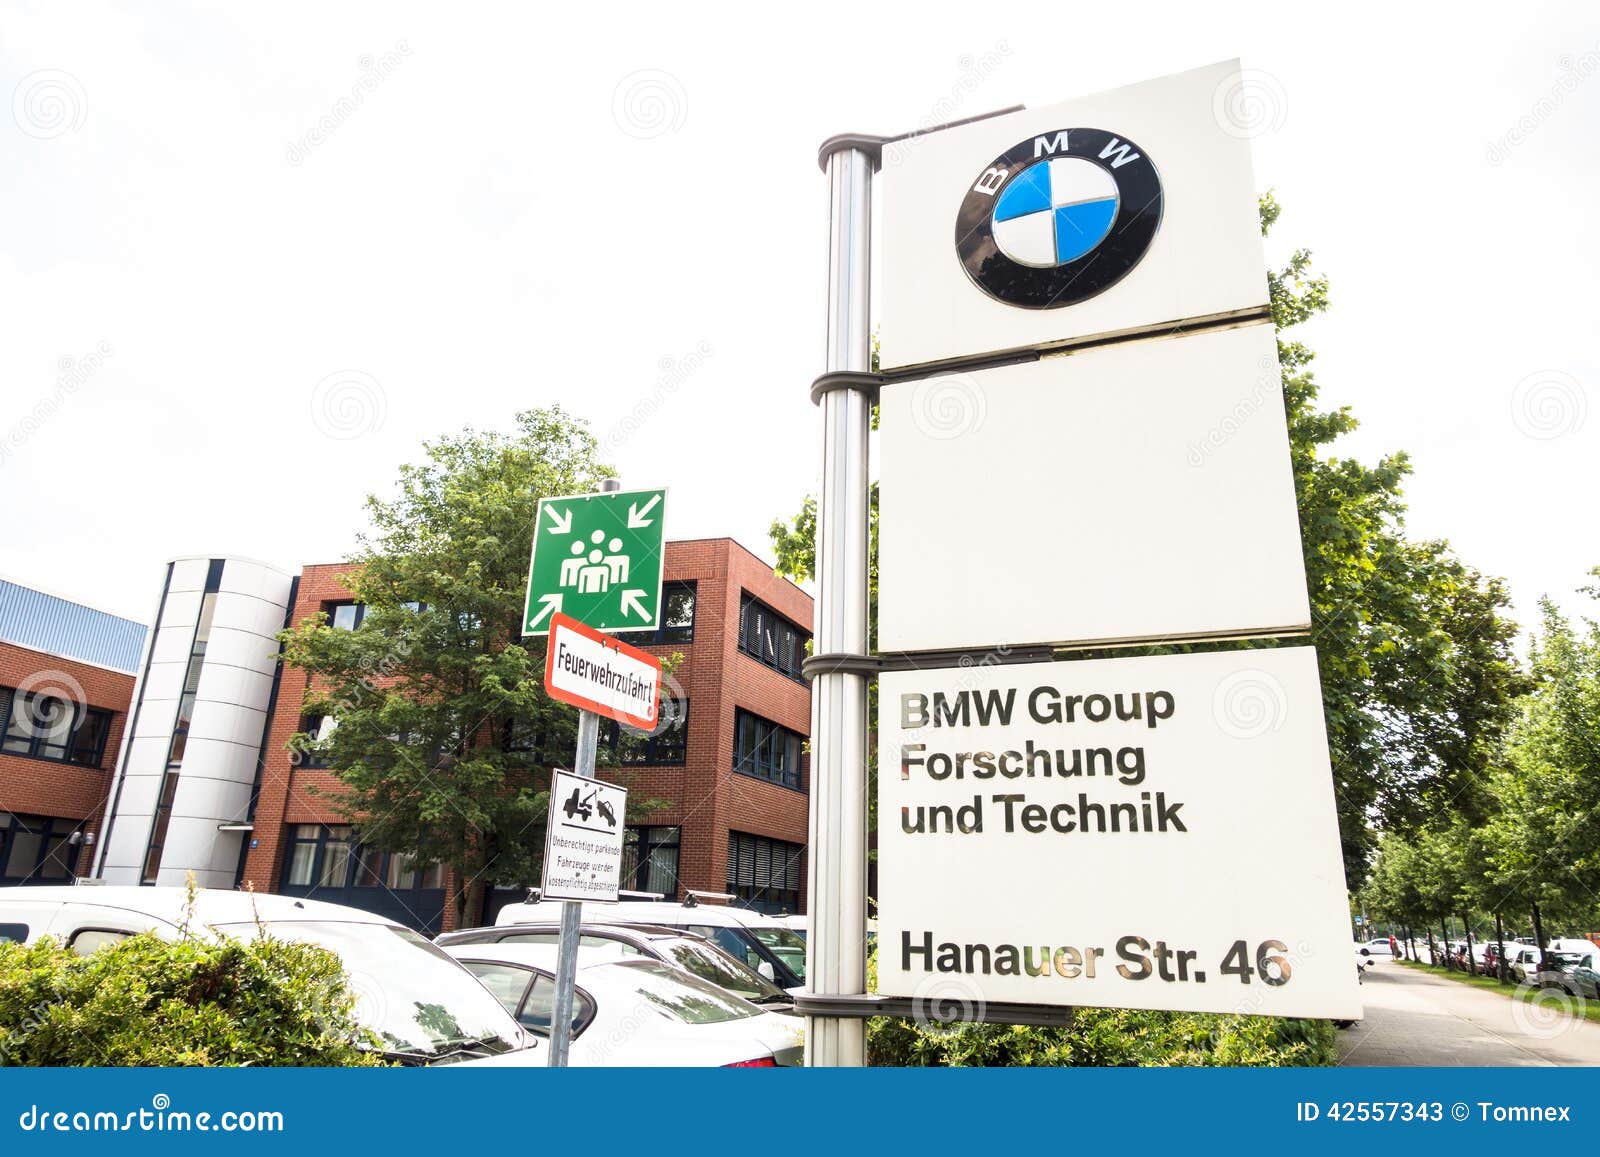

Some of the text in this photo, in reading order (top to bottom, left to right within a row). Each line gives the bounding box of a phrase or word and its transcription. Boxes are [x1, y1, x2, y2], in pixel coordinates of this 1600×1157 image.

[974, 131, 1140, 196] BMW
[558, 642, 652, 703] Feuerwehrzufahrt
[900, 685, 1176, 730] BMW Group
[900, 740, 1147, 786] Forschung
[900, 791, 1188, 834] und Technik
[557, 855, 614, 873] Fahrzeuge werden
[900, 930, 1293, 987] Hanauer Str. 46
